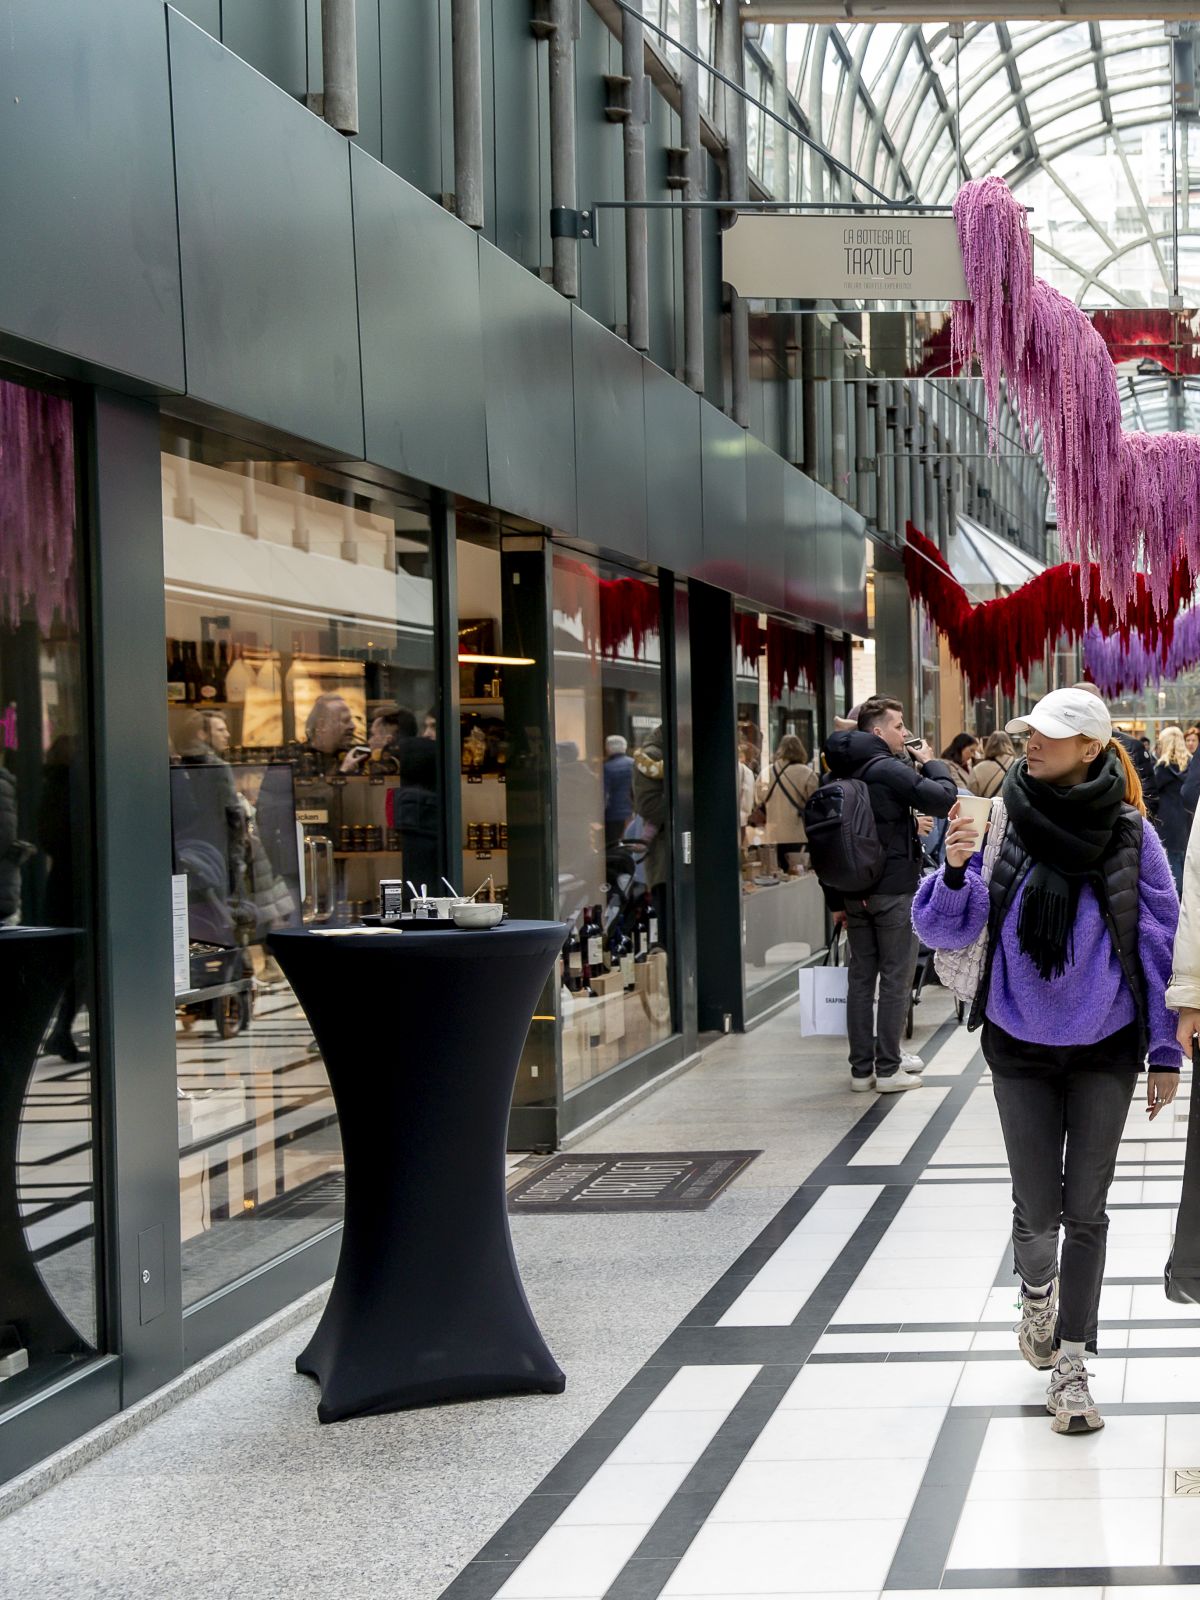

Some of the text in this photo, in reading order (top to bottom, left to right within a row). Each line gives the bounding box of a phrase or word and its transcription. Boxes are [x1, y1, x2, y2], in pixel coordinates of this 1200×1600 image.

[843, 229, 913, 245] LA BOTTEGA DEL
[843, 247, 913, 276] TARTUFO
[571, 1160, 693, 1200] TARTUFO
